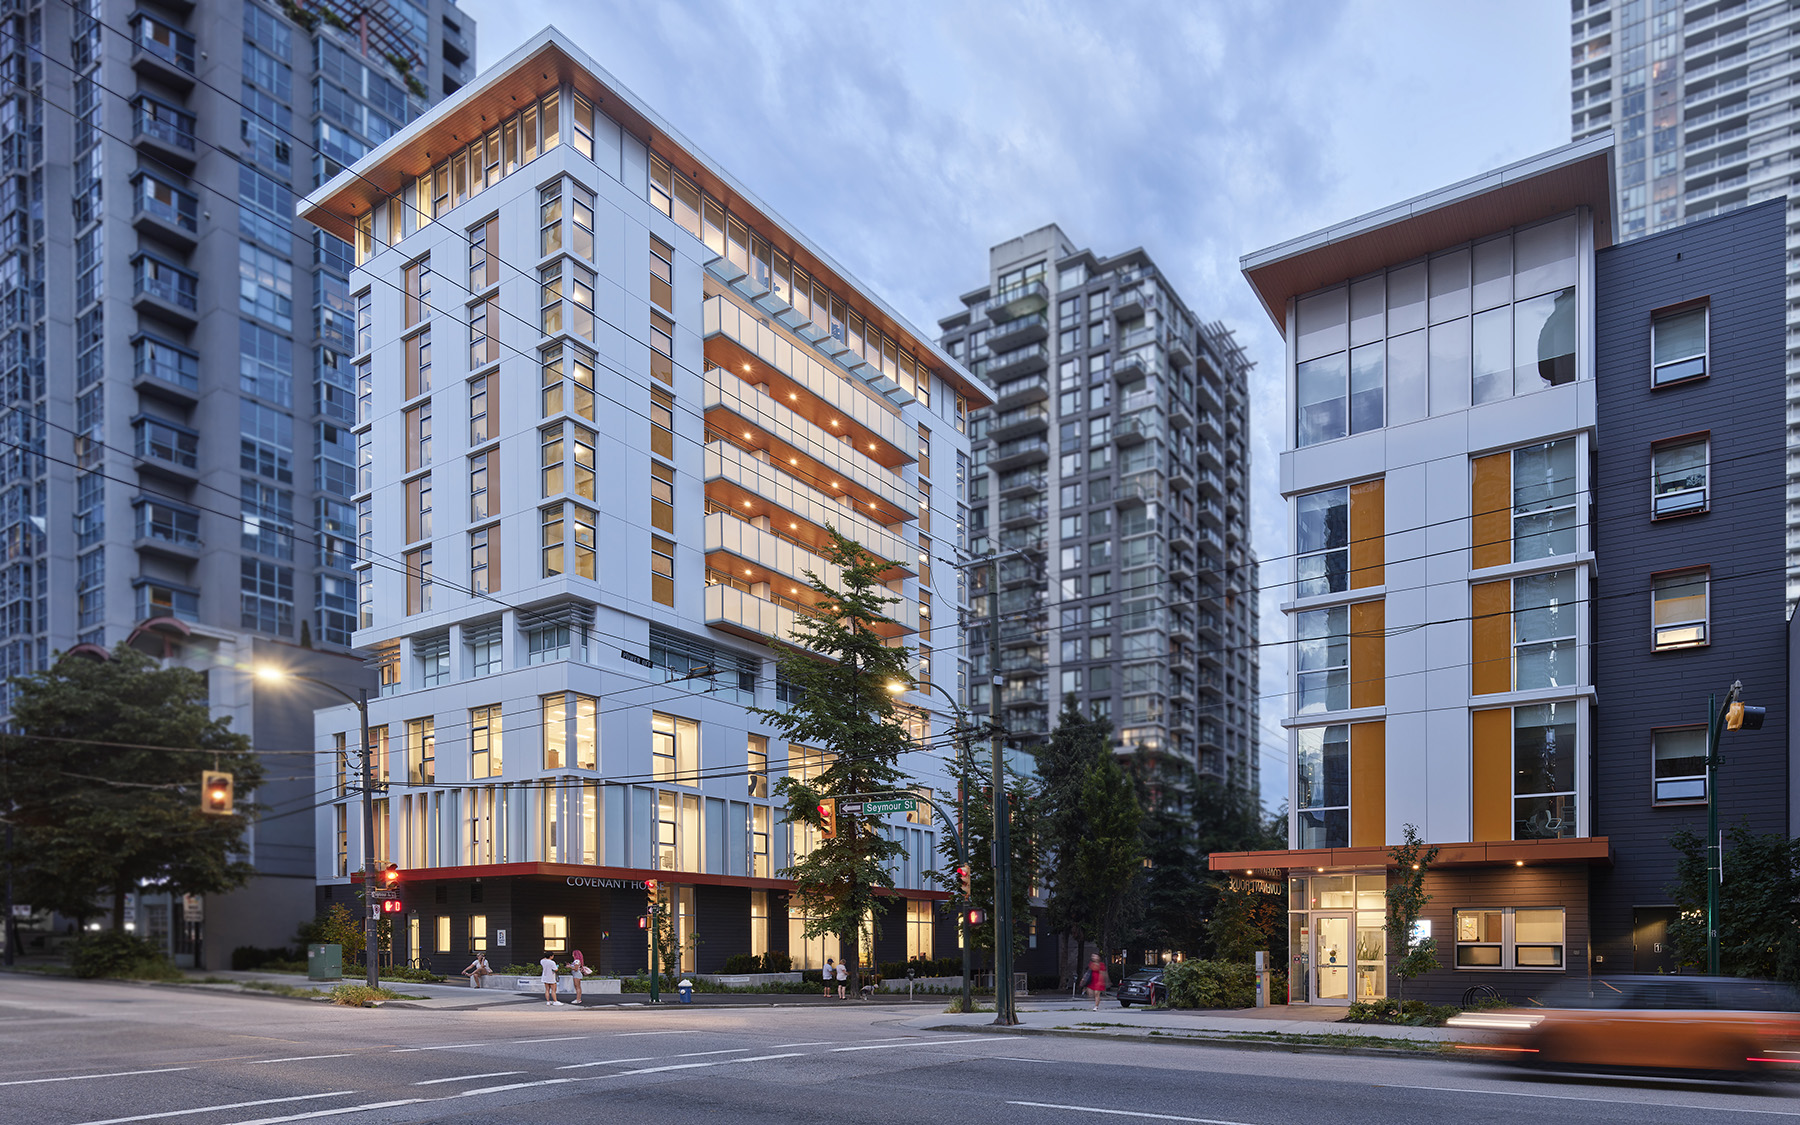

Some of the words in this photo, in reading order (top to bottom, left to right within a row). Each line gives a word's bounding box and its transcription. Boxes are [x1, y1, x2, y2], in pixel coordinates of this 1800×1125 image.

[622, 651, 641, 664] POWER
[866, 802, 901, 812] Seymour
[904, 800, 913, 809] St
[566, 876, 627, 889] COVENANT
[631, 881, 665, 891] HOSE
